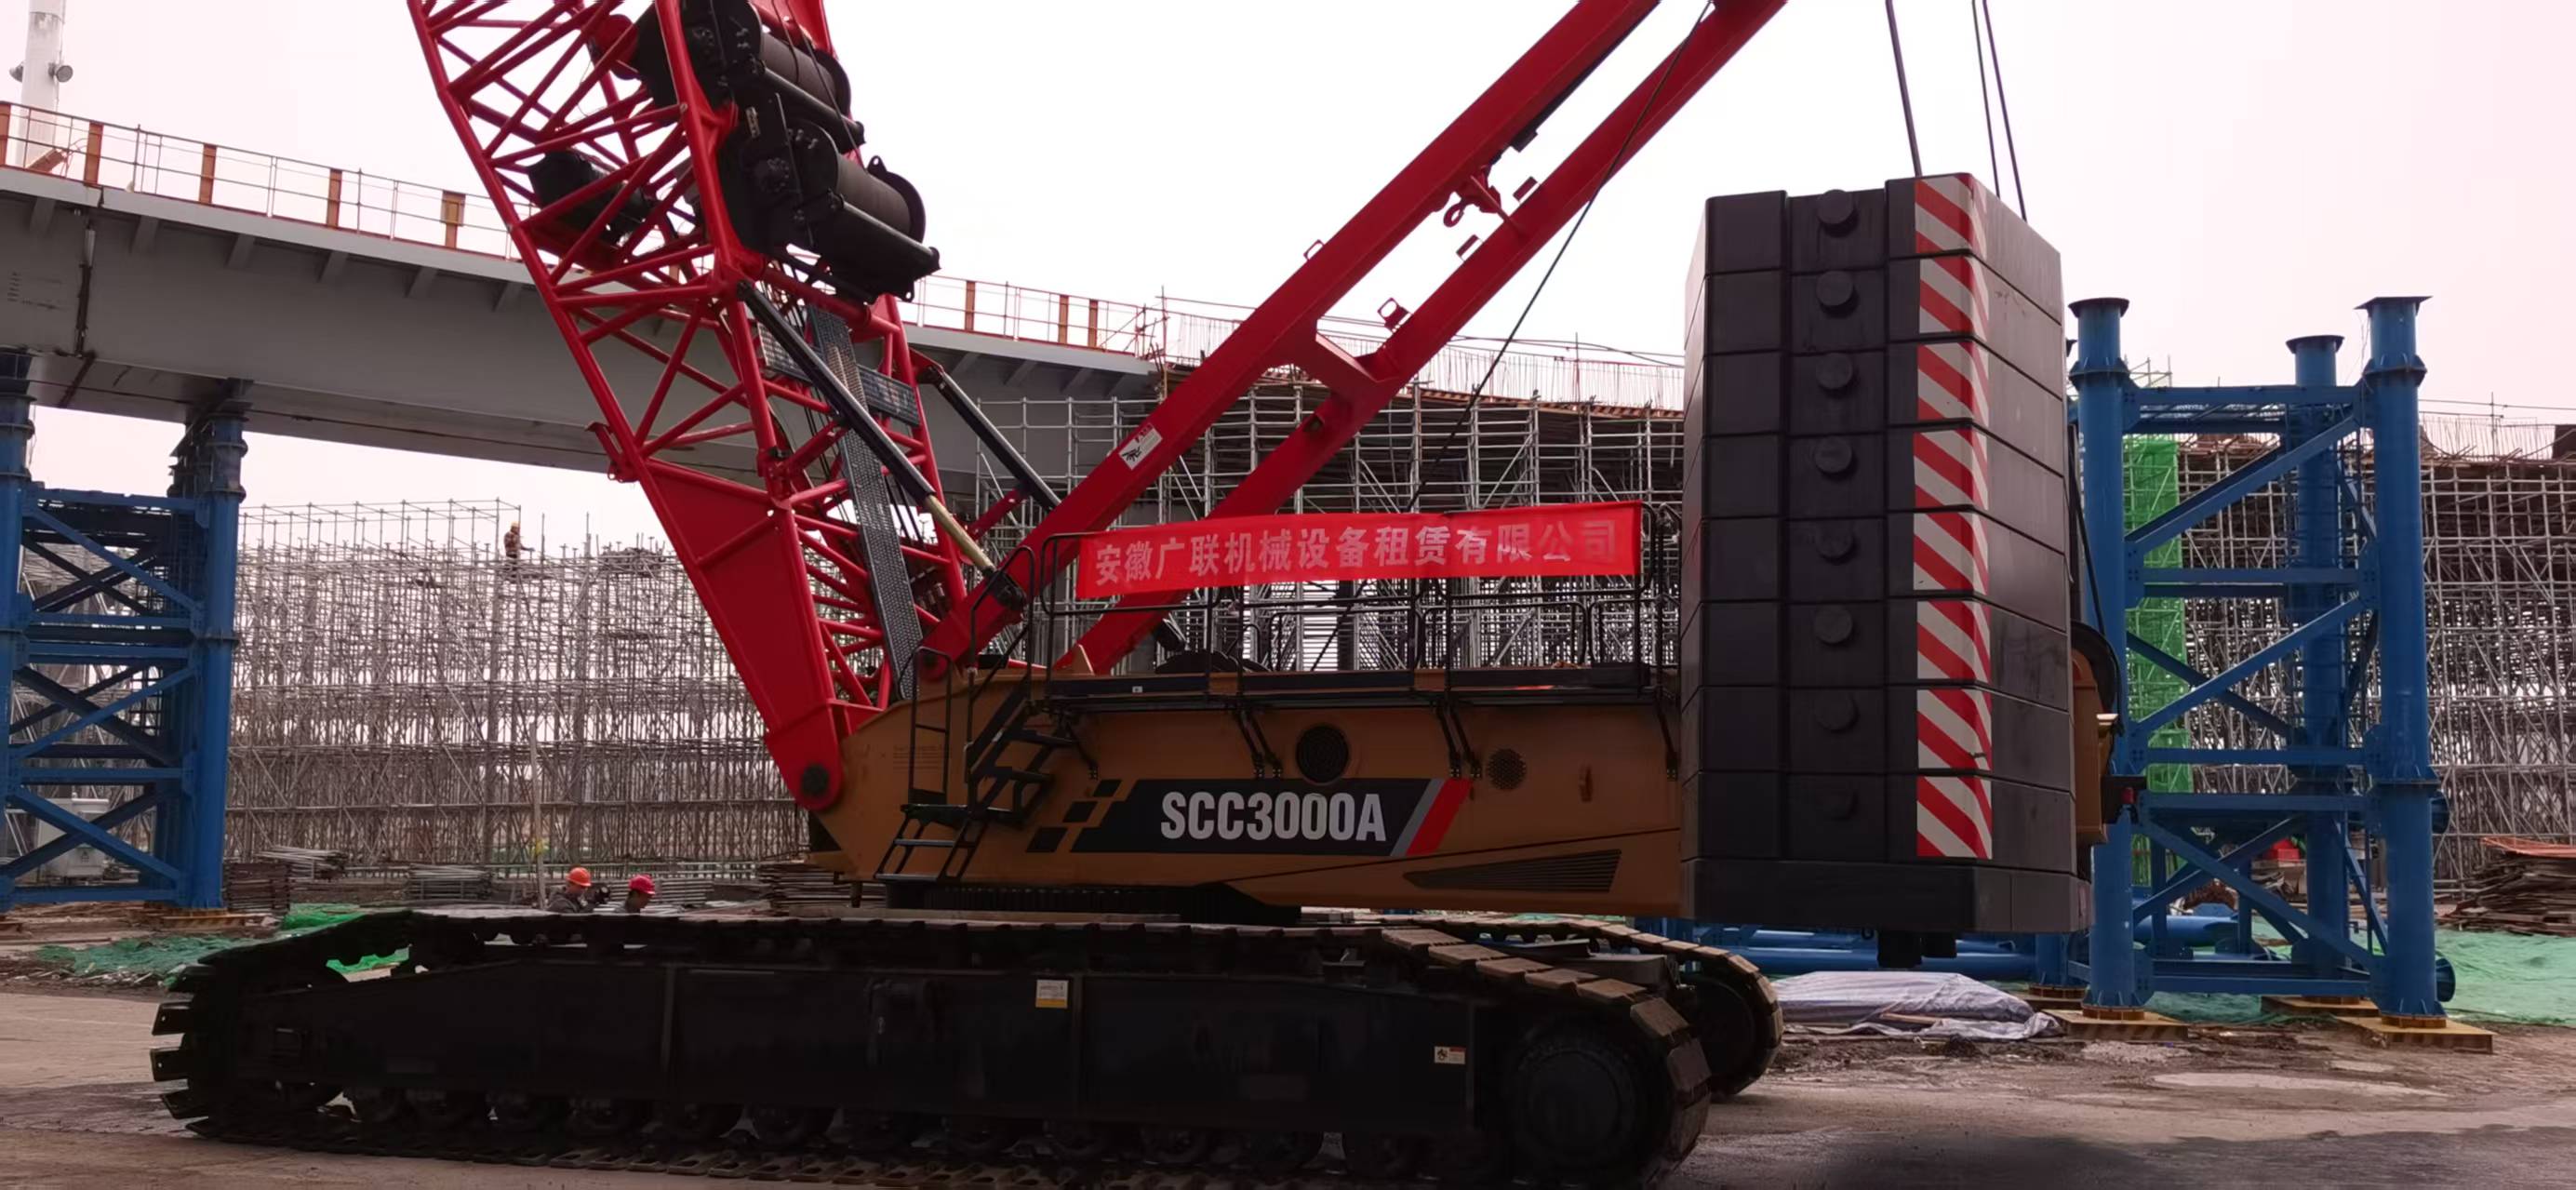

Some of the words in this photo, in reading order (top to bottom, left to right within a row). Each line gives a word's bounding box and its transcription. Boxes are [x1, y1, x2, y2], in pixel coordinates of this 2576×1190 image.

[1095, 519, 1616, 586] 安徽广联机械设备租赁有限公司
[1160, 791, 1386, 842] SCC3000A
